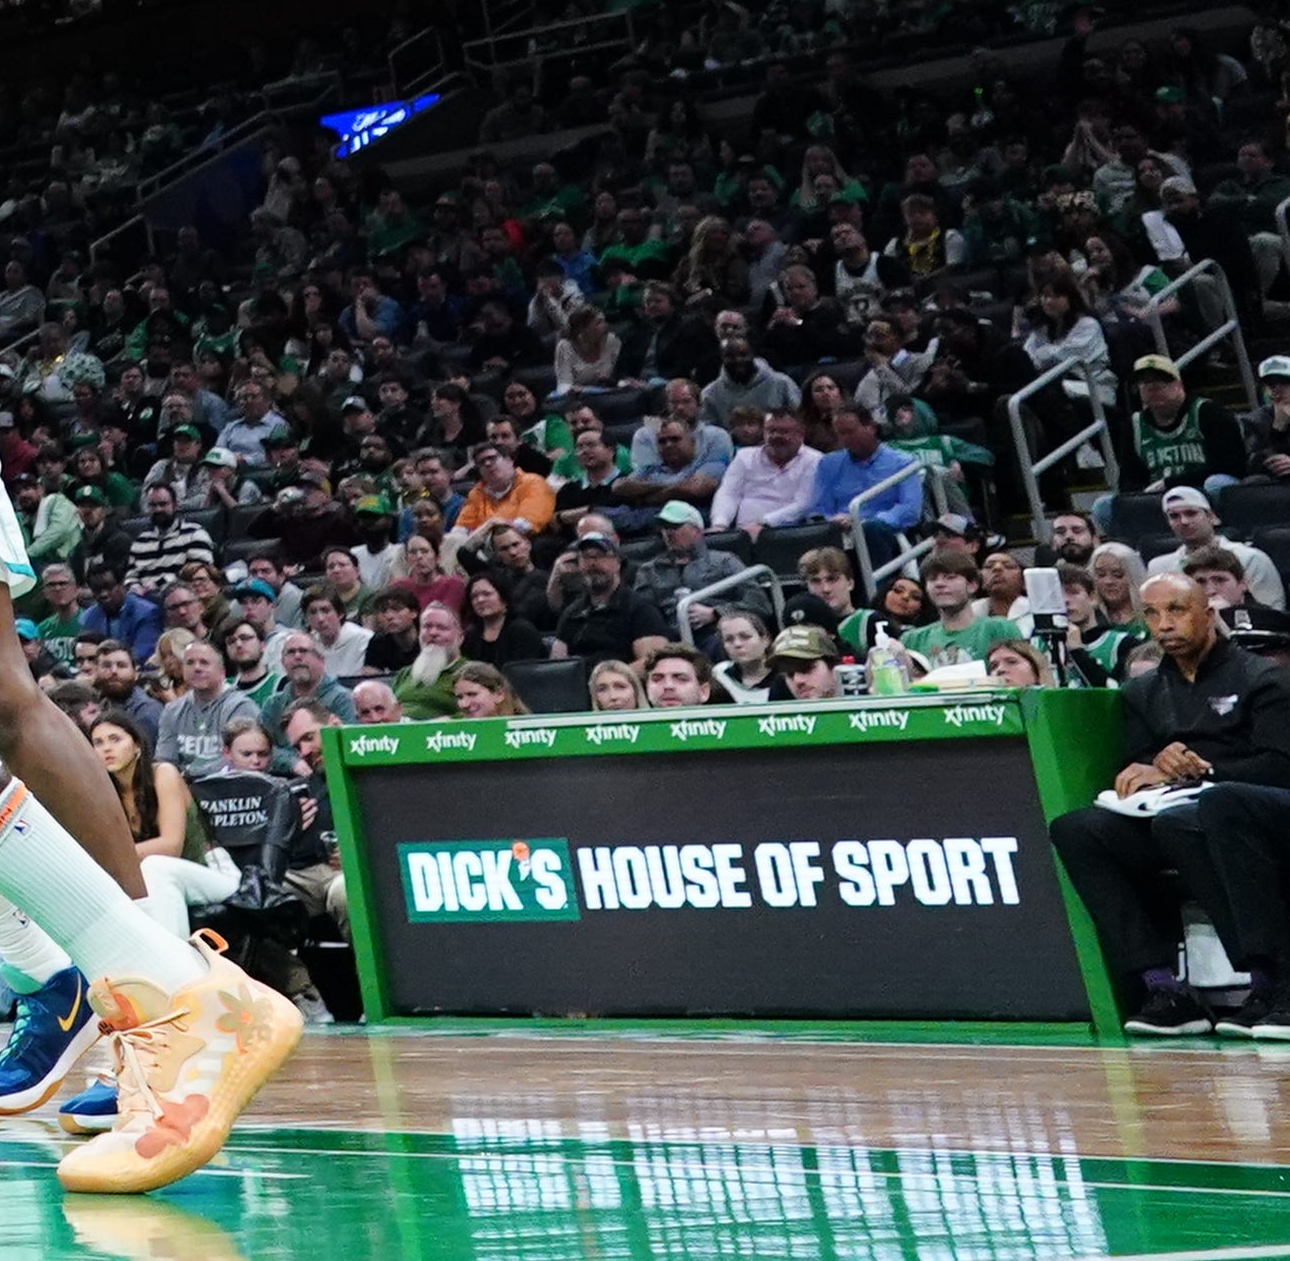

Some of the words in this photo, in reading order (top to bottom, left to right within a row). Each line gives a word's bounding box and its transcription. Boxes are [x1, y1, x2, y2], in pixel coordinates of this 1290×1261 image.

[757, 713, 818, 737] xfinity
[848, 709, 910, 732] xfinity
[943, 703, 1006, 727] xfinity
[504, 727, 557, 748] xfinity
[585, 723, 641, 745] xfinity
[670, 717, 727, 741] xfinity
[350, 734, 400, 756] xfinity
[426, 730, 478, 752] xfinity
[214, 810, 268, 828] PLETON
[407, 842, 569, 913] DICK'S
[577, 843, 753, 910] HOUSE
[754, 842, 825, 909] OF
[831, 836, 1021, 907] SPORT
